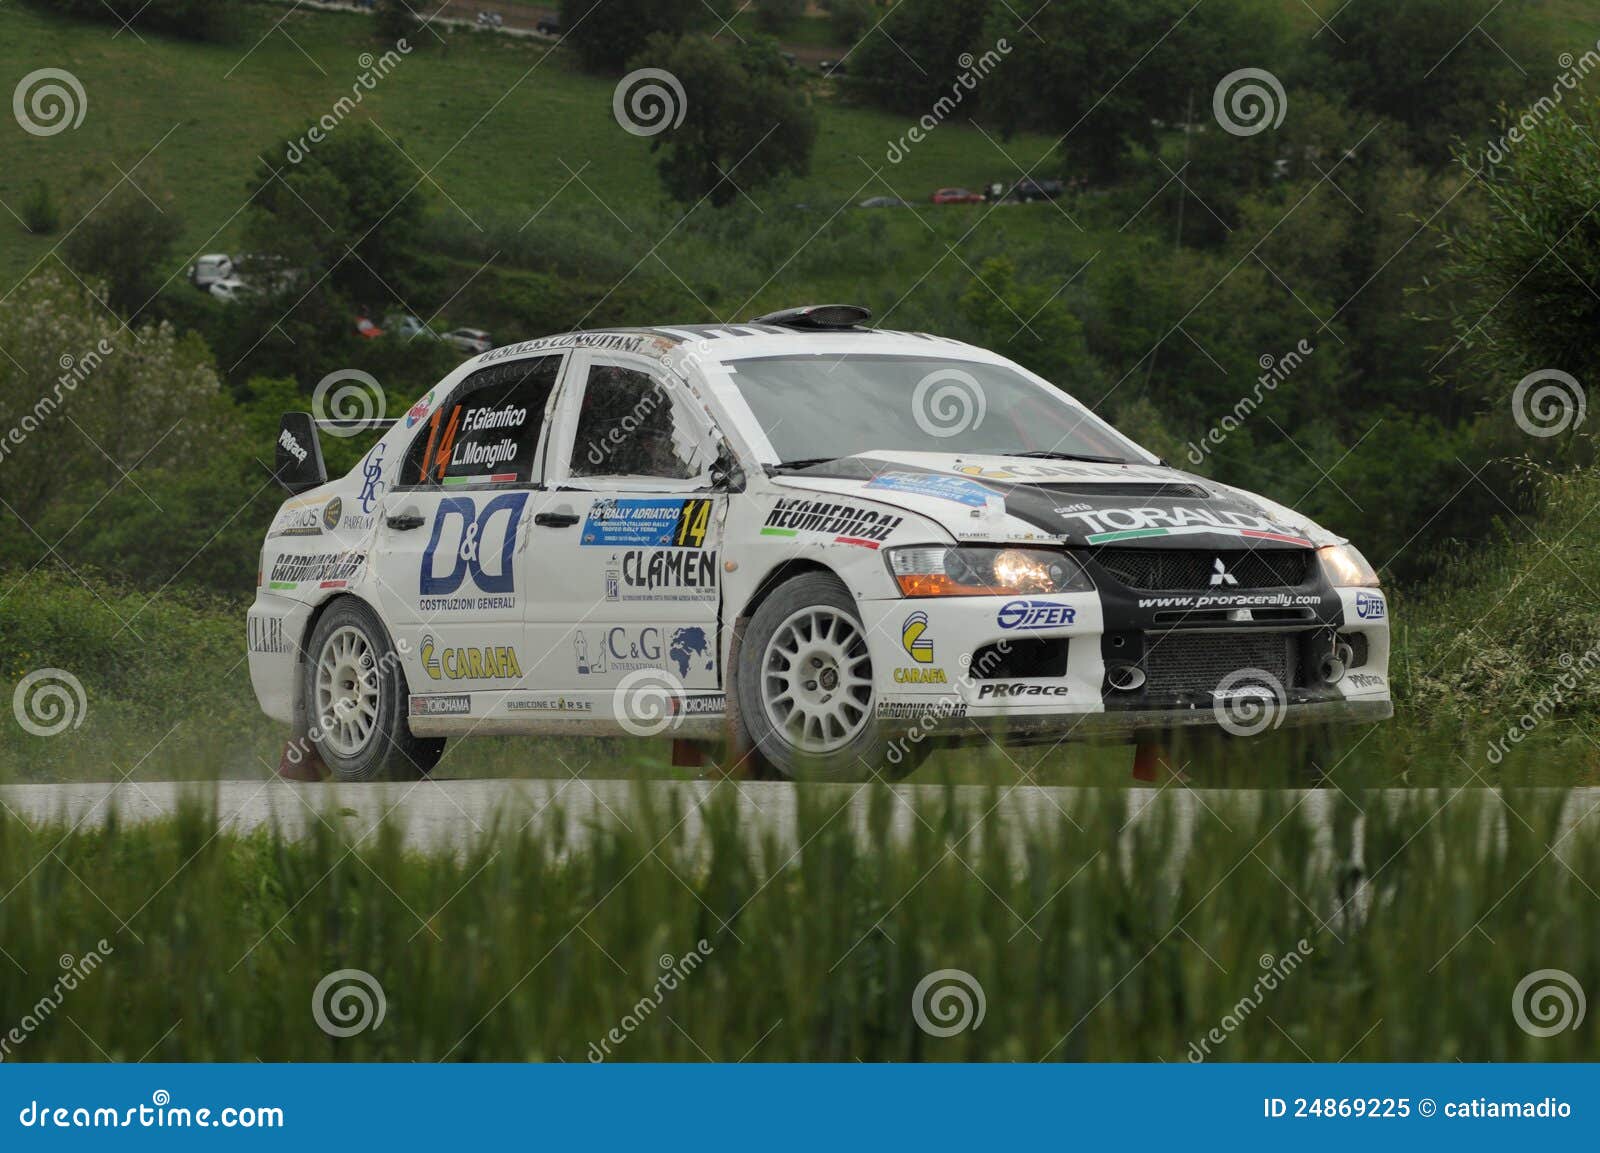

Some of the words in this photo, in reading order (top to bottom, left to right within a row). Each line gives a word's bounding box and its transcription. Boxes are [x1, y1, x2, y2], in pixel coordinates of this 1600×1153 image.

[419, 404, 462, 482] 14
[451, 438, 518, 468] L.Mongillo
[632, 508, 680, 519] ADRIATICO
[678, 500, 711, 547] 14
[764, 498, 904, 541] NEOMEDICAL
[622, 550, 717, 591] CLAMEN
[420, 598, 475, 611] COSTRUZIONI
[478, 597, 515, 609] GENERALI
[1138, 593, 1321, 608] www.proracerally.com
[441, 646, 523, 679] CARAFA
[893, 668, 947, 684] CARAFA
[426, 698, 470, 713] YOKOHAMA
